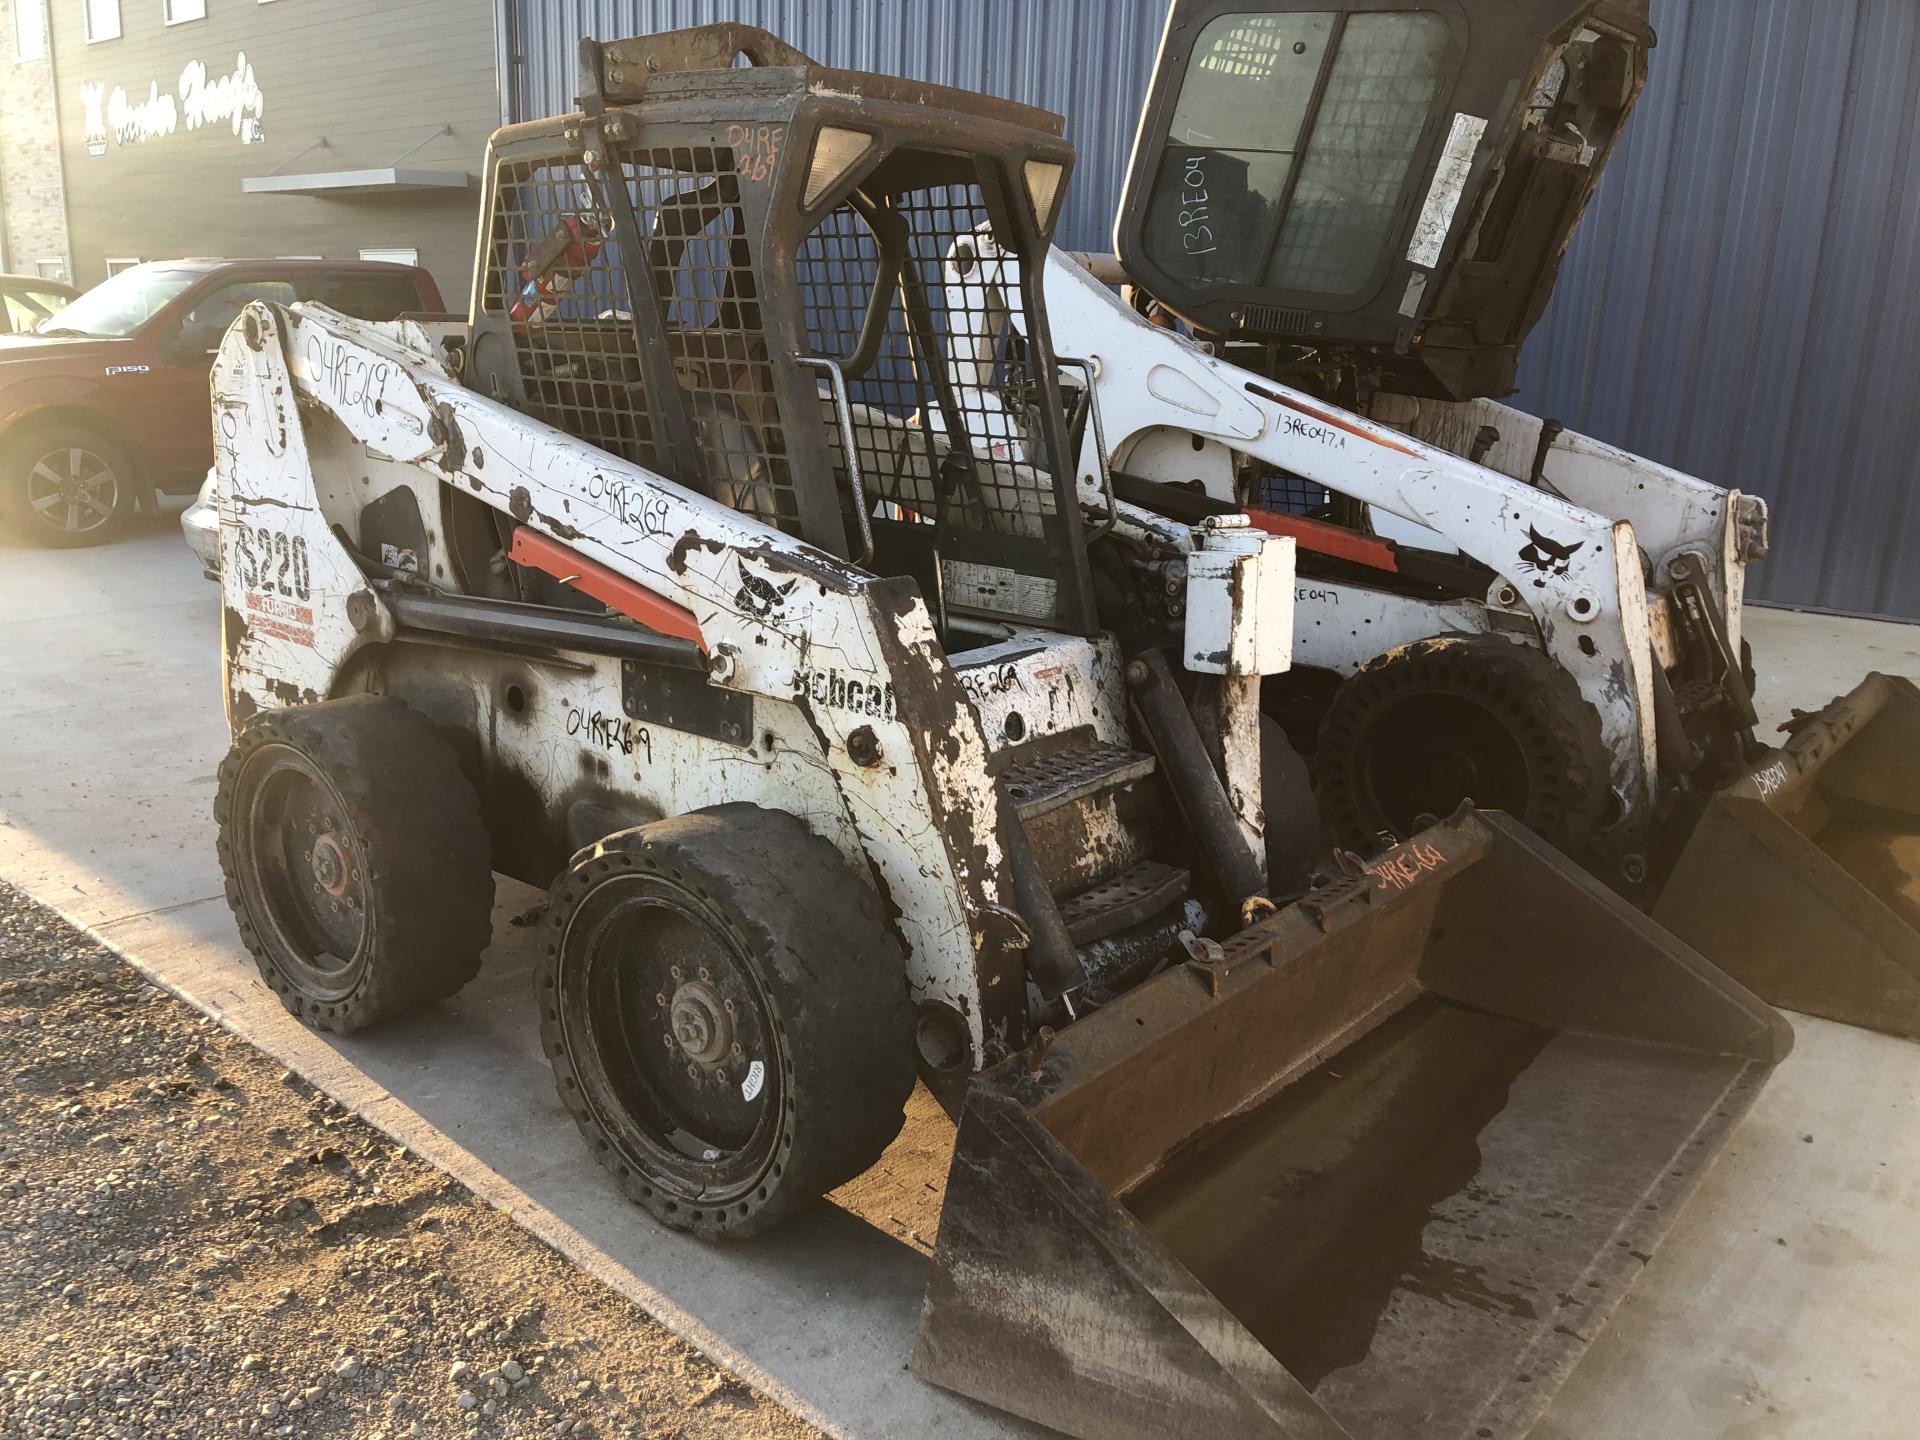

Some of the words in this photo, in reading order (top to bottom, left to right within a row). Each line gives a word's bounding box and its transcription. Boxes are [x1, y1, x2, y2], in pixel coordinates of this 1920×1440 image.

[307, 334, 391, 418] 04RE269
[588, 474, 670, 536] 04RE269
[240, 526, 311, 601] S220
[566, 706, 652, 765] 04RE269
